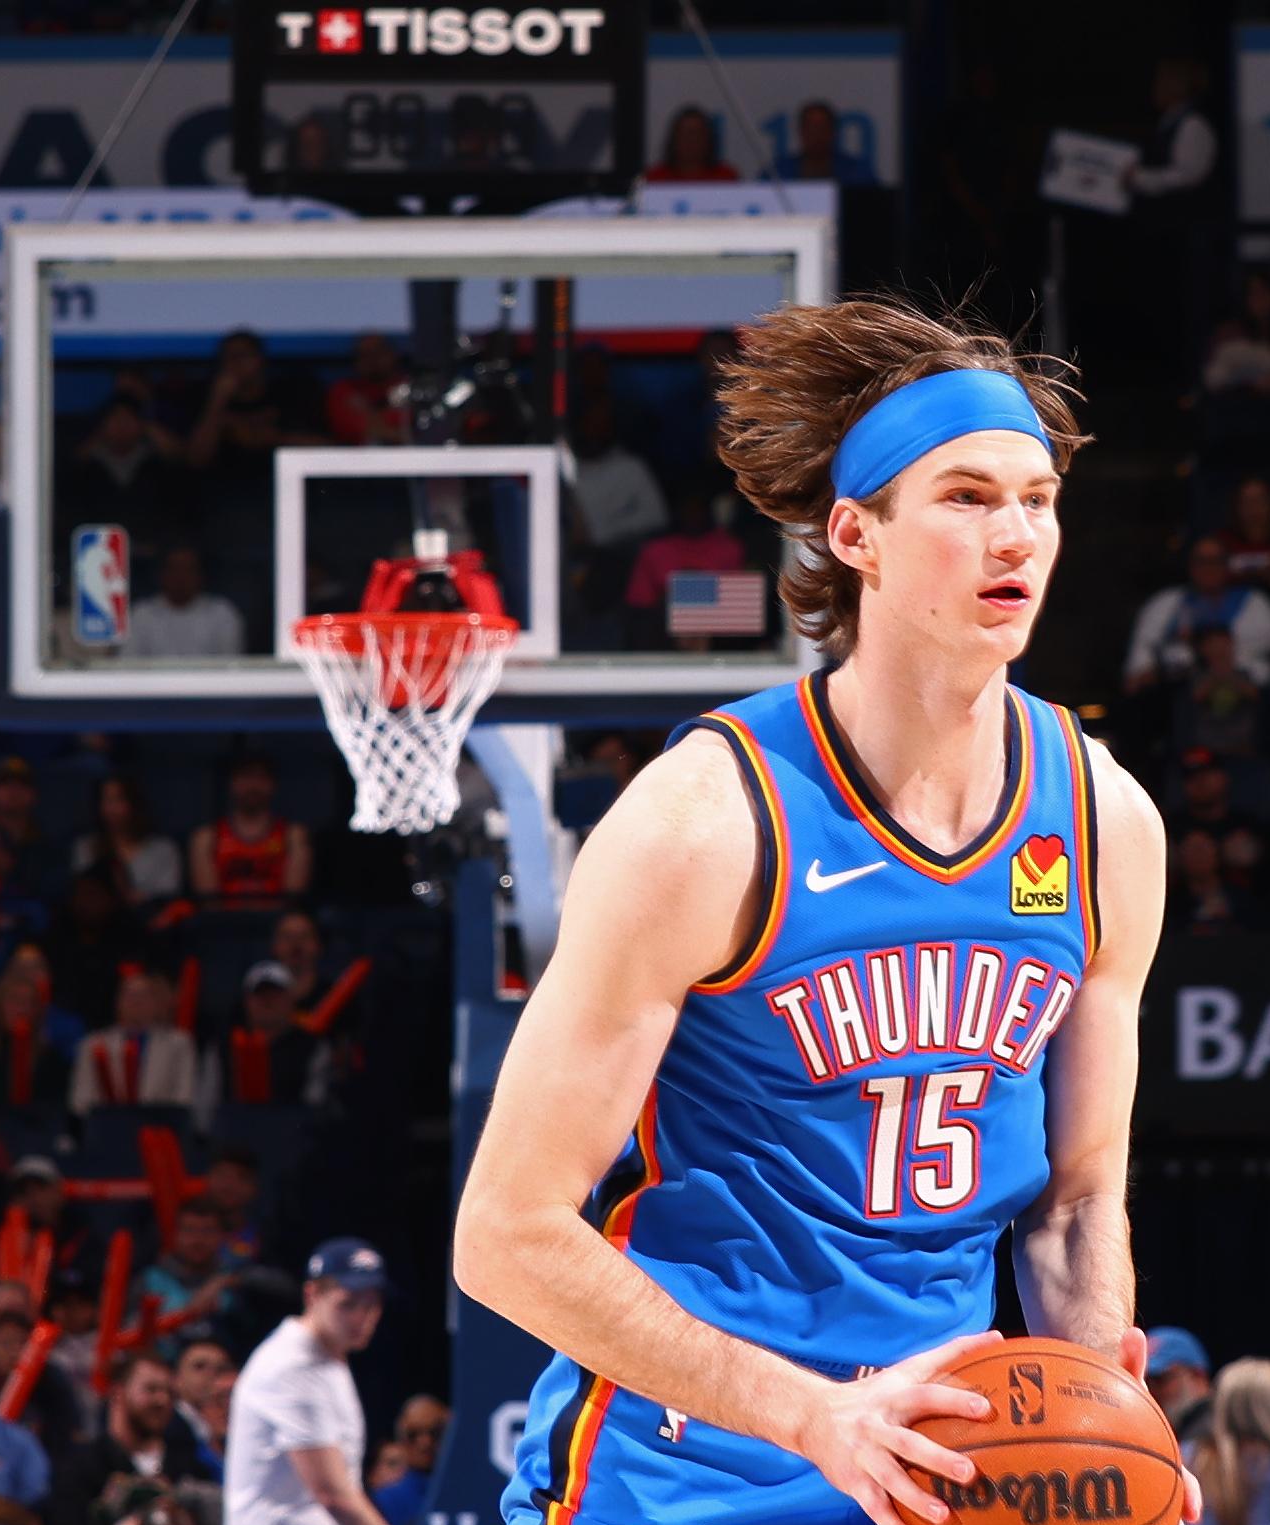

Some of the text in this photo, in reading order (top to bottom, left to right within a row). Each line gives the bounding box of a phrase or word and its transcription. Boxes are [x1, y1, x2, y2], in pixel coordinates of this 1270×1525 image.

[365, 7, 606, 57] TISSOT
[766, 942, 1079, 1083] THUNDER
[861, 1065, 994, 1220] 15
